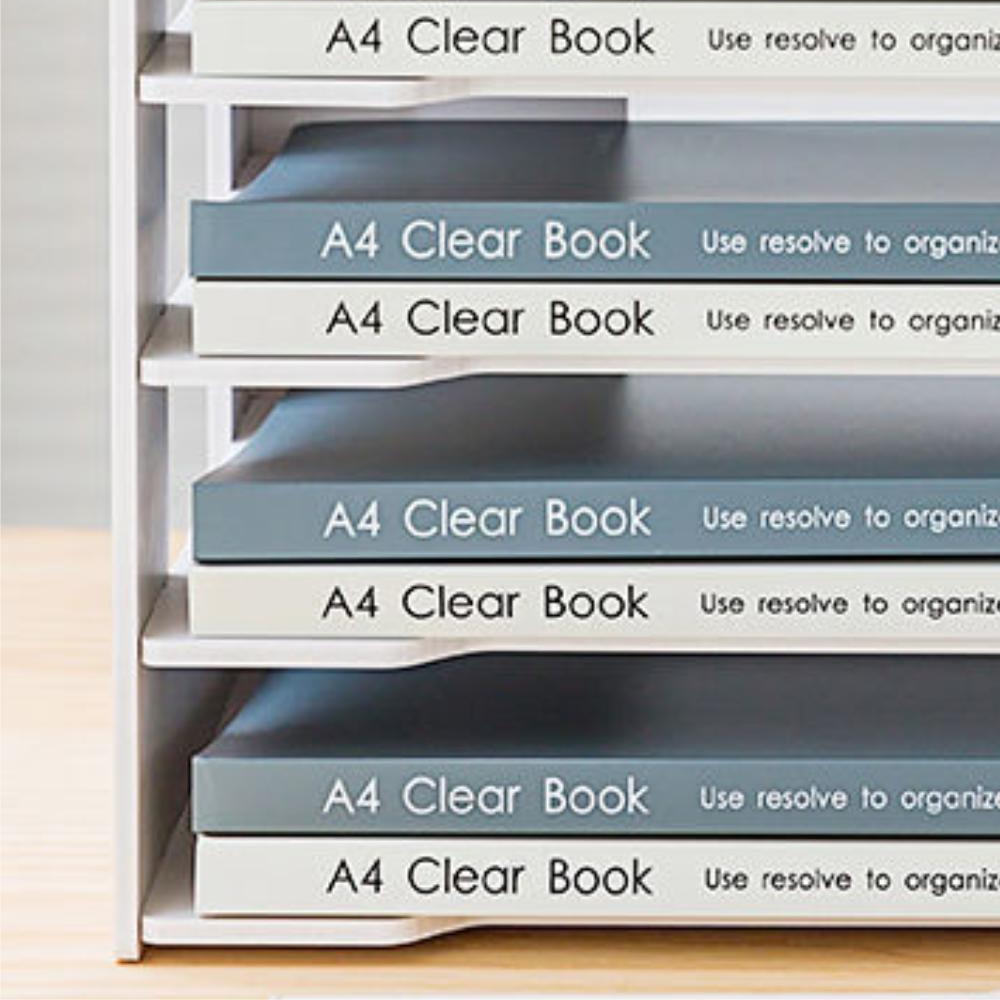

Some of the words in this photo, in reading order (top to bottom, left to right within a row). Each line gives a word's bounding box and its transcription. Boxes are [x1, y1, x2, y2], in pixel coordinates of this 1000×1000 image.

[325, 18, 382, 54] A4
[406, 15, 527, 56] Clear
[550, 17, 656, 57] Book
[708, 28, 752, 51] Use
[765, 28, 857, 51] resolve
[871, 29, 897, 52] to
[320, 220, 379, 259] A4
[401, 219, 523, 260] Clear
[545, 219, 651, 260] Book
[702, 229, 747, 254] Use
[759, 229, 852, 254] resolve
[864, 230, 891, 254] to
[325, 300, 383, 335] A4
[406, 298, 526, 337] Clear
[550, 299, 655, 337] Book
[706, 309, 751, 331] Use
[763, 309, 855, 332] resolve
[869, 310, 896, 332] to
[323, 500, 381, 538] A4
[404, 498, 523, 538] Clear
[546, 497, 652, 536] Book
[703, 506, 748, 530] Use
[760, 505, 852, 530] resolve
[864, 505, 891, 528] to
[321, 585, 379, 619] A4
[401, 583, 521, 621] Clear
[543, 584, 649, 621] Book
[700, 593, 745, 615] Use
[757, 593, 849, 615] resolve
[863, 593, 889, 615] to
[322, 777, 381, 814] A4
[402, 775, 522, 815] Clear
[544, 775, 649, 815] Book
[700, 786, 745, 810] Use
[757, 785, 848, 810] resolve
[861, 786, 888, 810] to
[325, 857, 384, 894] A4
[407, 855, 526, 896] Clear
[548, 857, 653, 897] Book
[705, 867, 749, 891] Use
[761, 868, 853, 892] resolve
[866, 868, 892, 892] to
